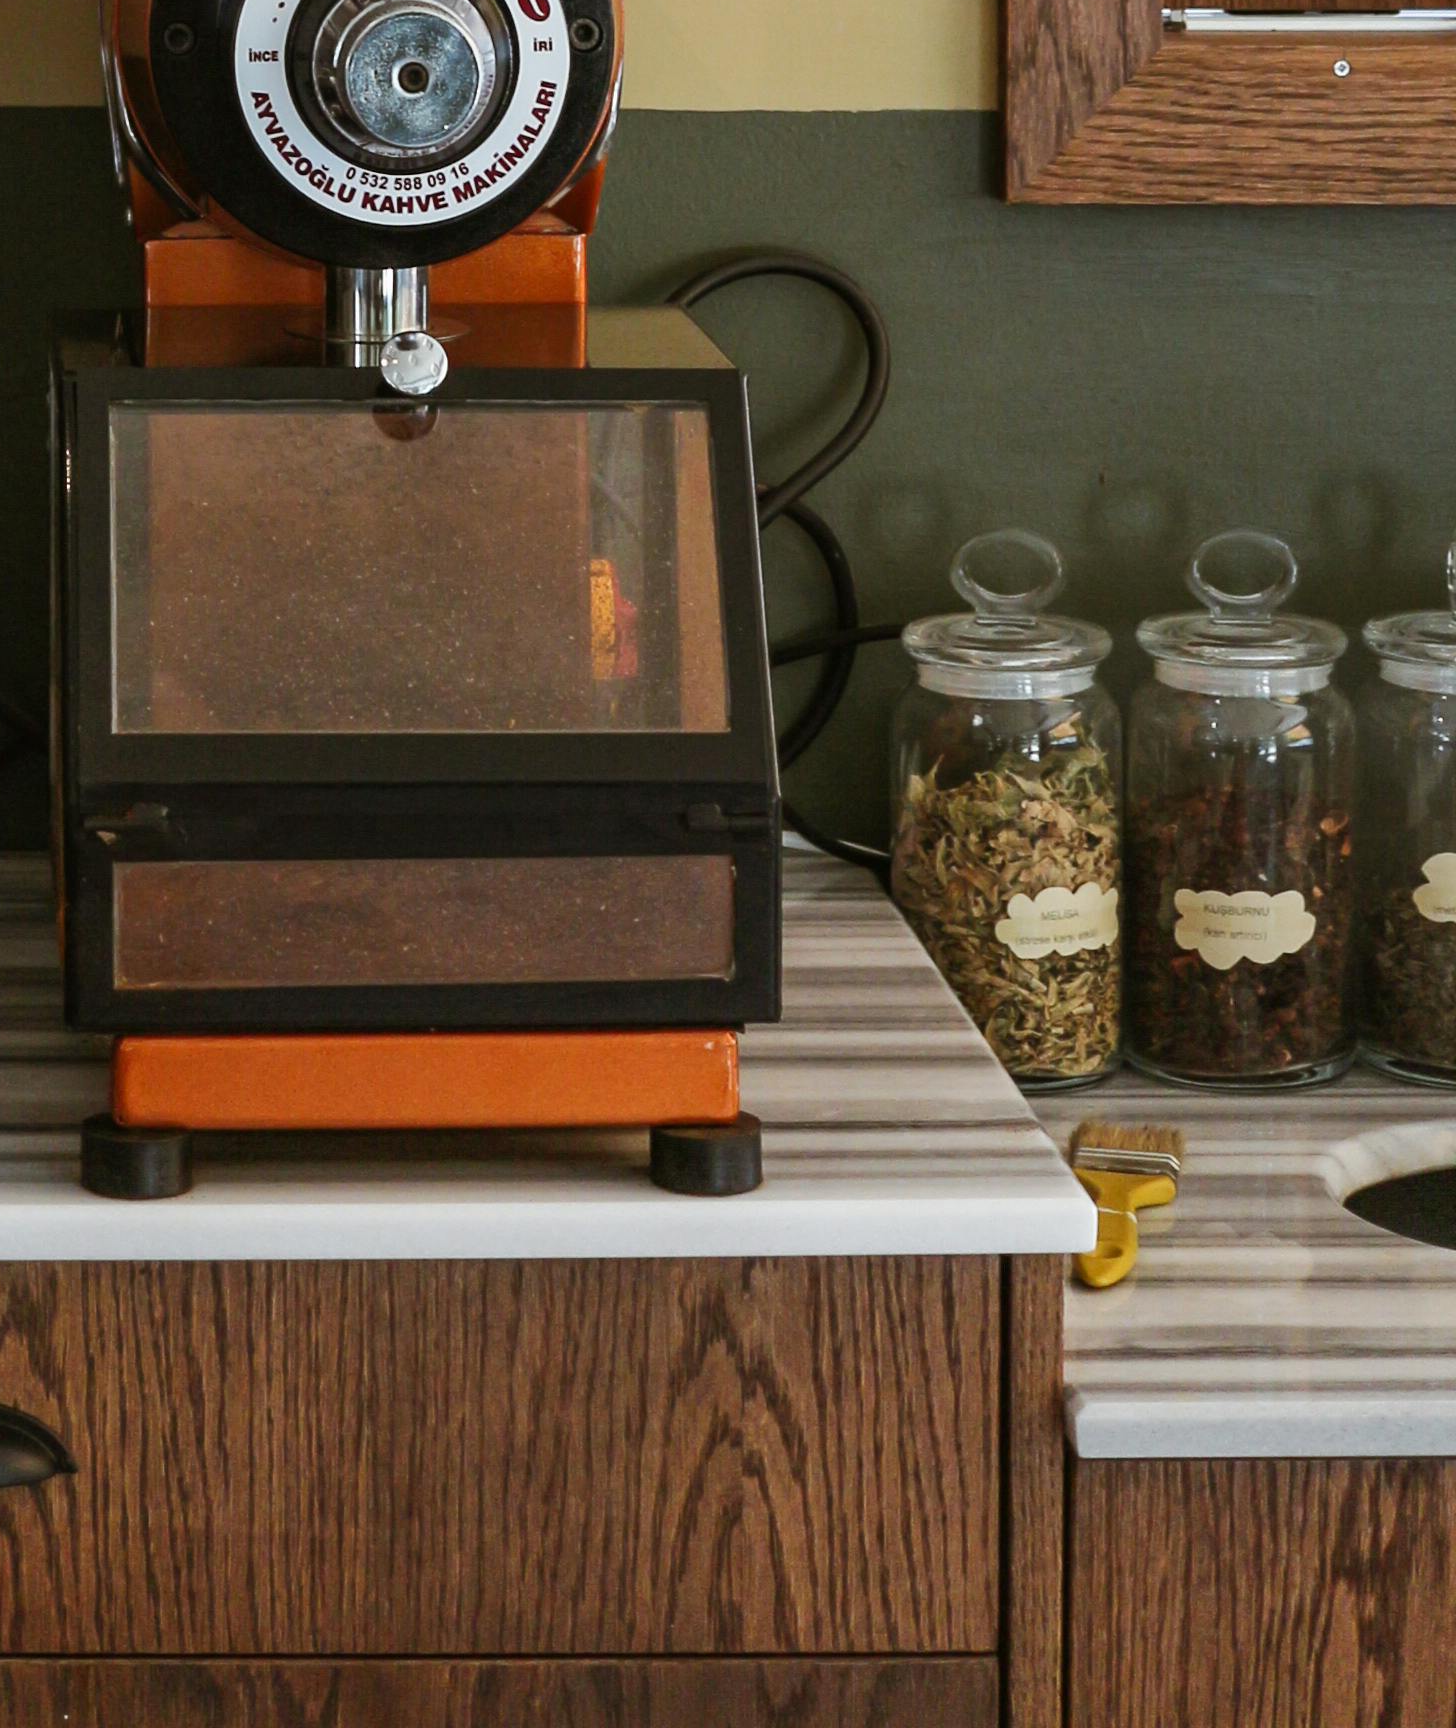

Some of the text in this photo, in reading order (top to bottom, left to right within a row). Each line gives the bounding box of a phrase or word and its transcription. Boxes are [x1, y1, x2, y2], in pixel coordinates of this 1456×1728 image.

[248, 48, 279, 63] İNCE
[533, 38, 553, 52] İRİ
[250, 80, 558, 213] AYVAZOĞLU KAHVE MAKİNALARI
[346, 162, 470, 191] 0 532 588 09 16
